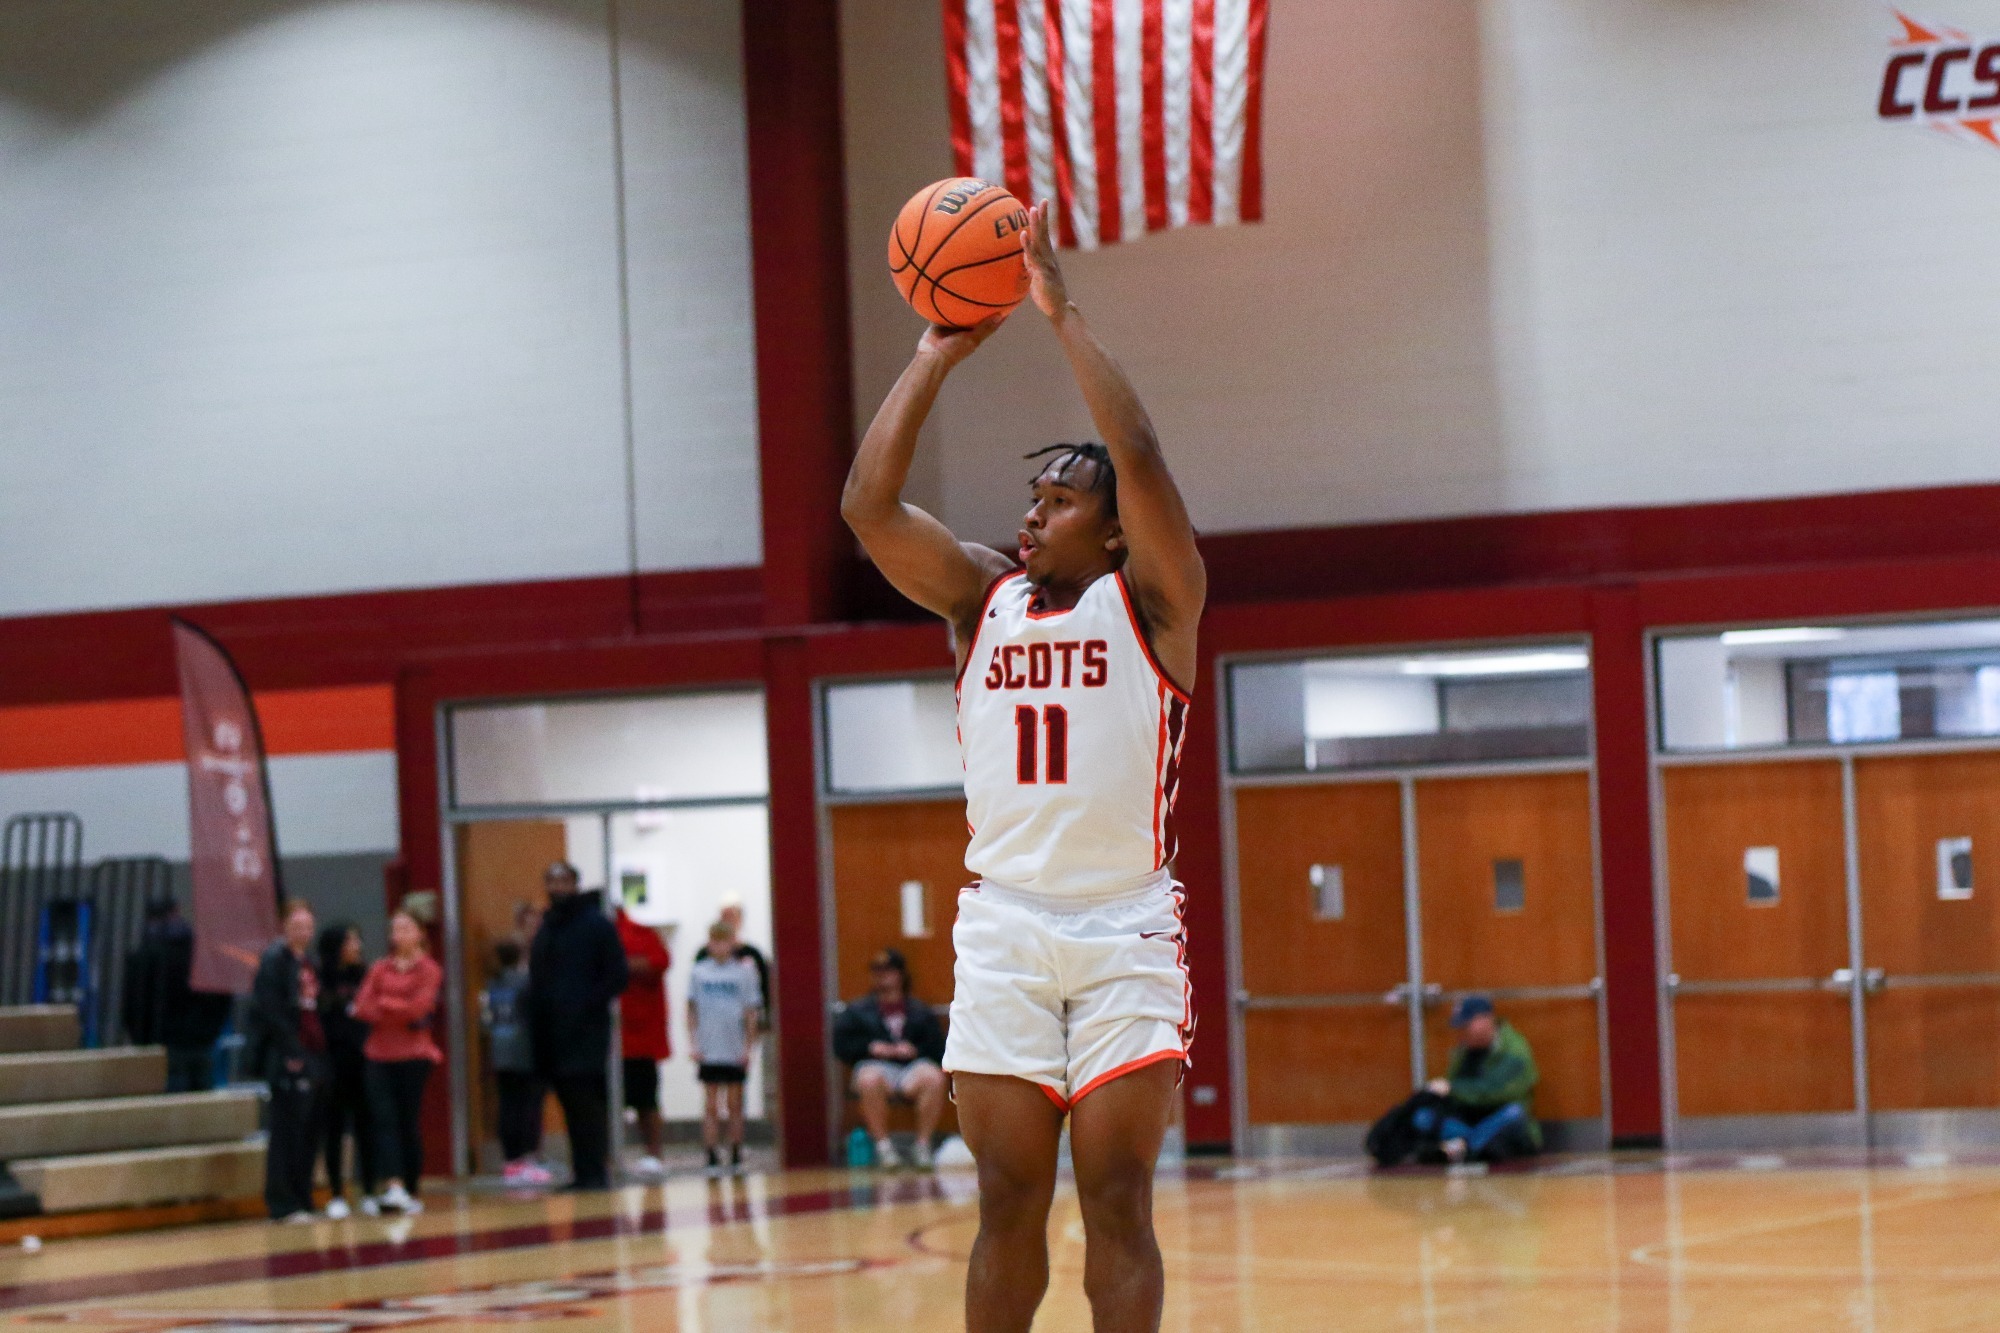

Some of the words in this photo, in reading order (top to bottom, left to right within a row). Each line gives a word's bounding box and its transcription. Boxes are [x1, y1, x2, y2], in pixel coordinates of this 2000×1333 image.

[1879, 45, 2000, 118] CCS
[985, 639, 1107, 691] SCOTS
[1015, 703, 1067, 785] 11
